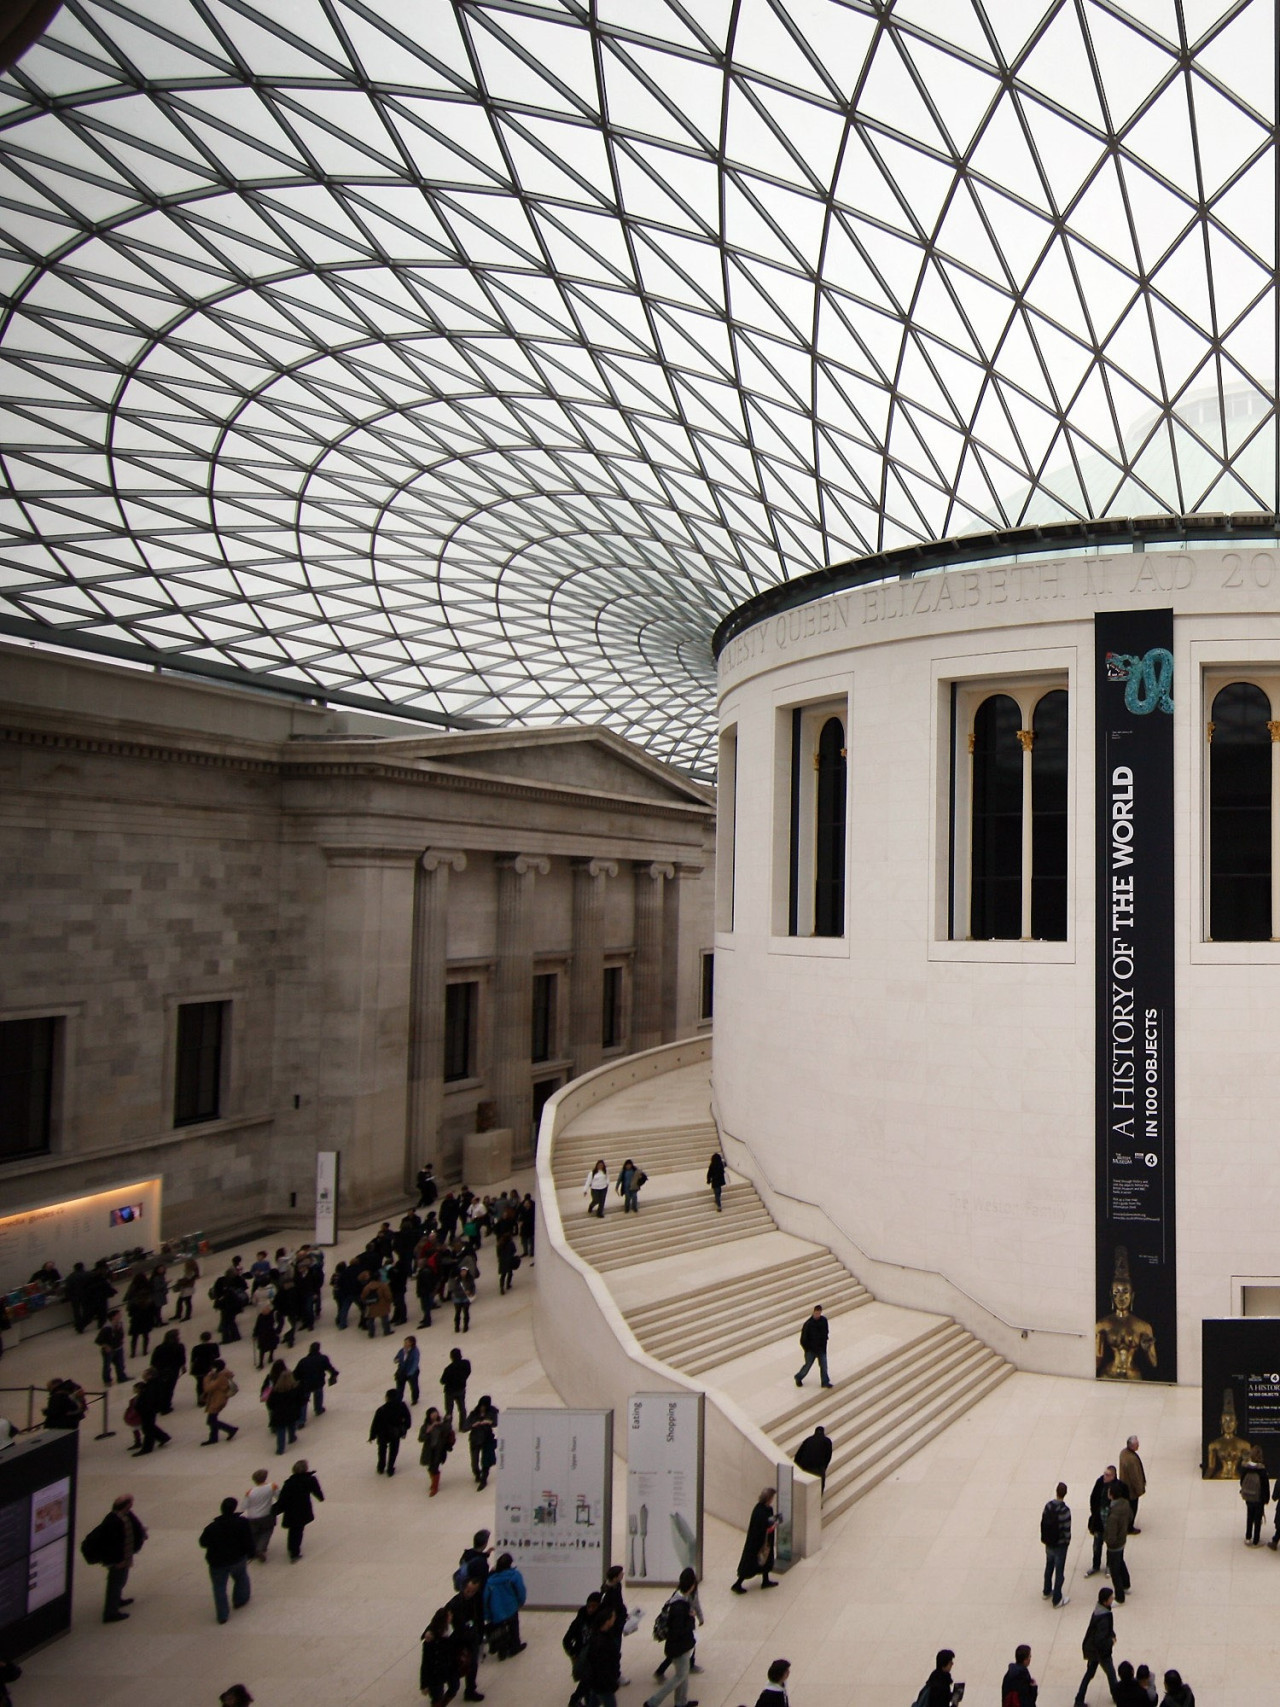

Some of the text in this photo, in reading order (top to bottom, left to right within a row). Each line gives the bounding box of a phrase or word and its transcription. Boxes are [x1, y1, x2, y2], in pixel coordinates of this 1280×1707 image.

[775, 596, 851, 650] QUEEN
[862, 562, 1066, 624] ELIZABETH
[1082, 559, 1114, 596] II
[1130, 553, 1198, 593] AD
[1112, 766, 1136, 1138] A HISTORY OF THE WORLD
[1144, 1008, 1158, 1137] IN 100 OBJECTS
[632, 1402, 643, 1430] Eating
[667, 1402, 677, 1443] Shopping
